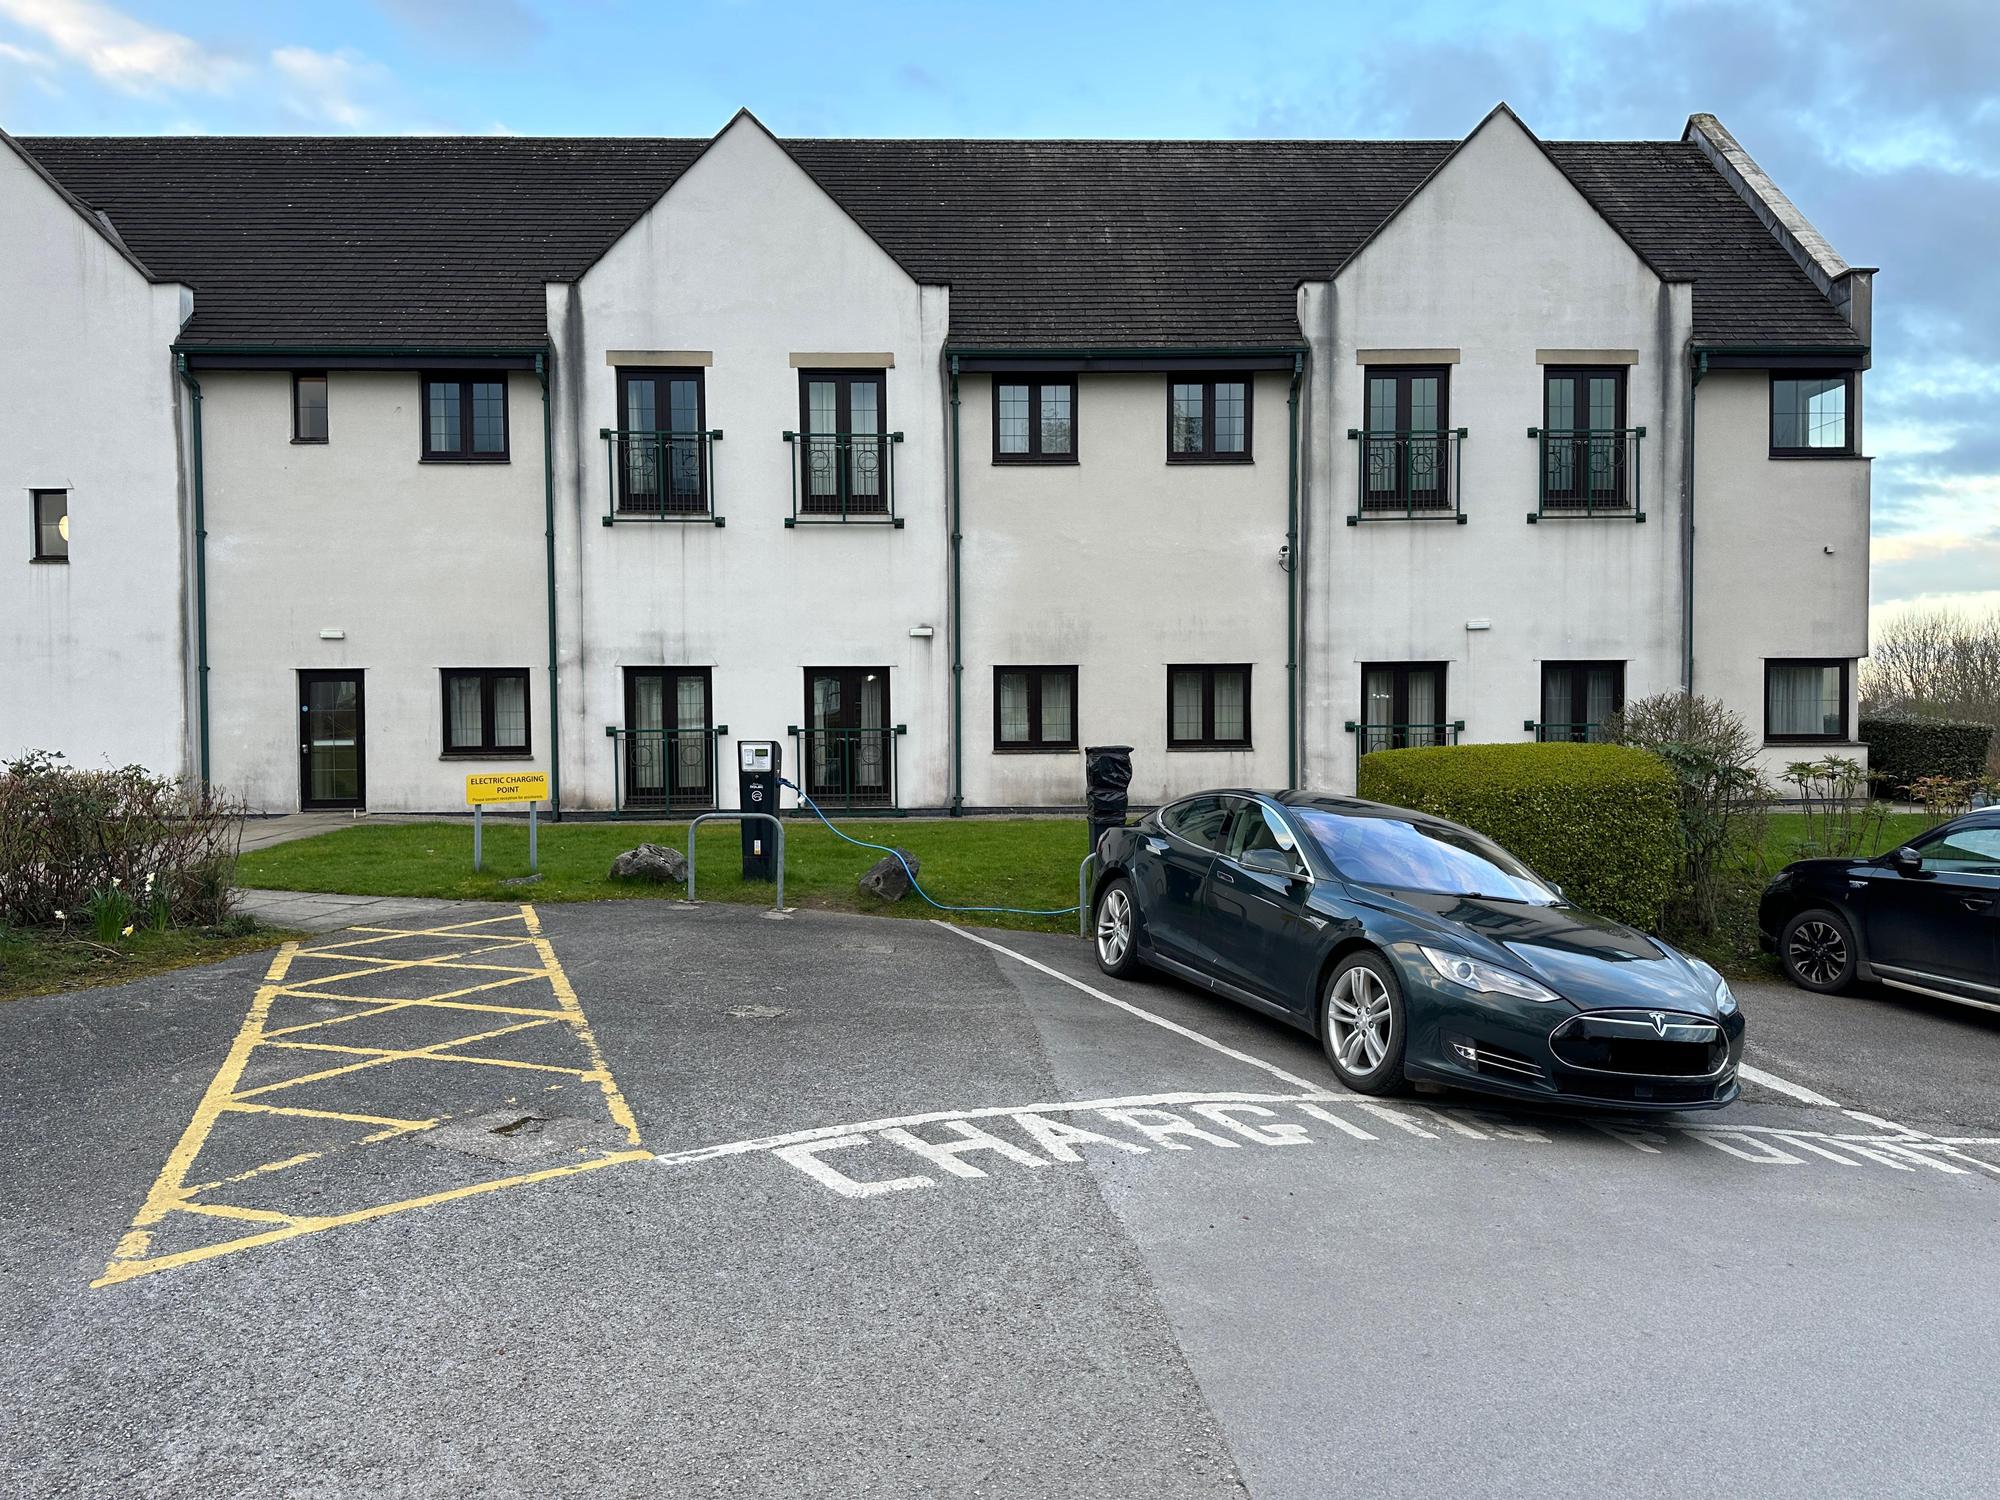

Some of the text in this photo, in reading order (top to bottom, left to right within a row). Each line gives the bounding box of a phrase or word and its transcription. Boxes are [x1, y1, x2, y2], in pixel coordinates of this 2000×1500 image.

[471, 775, 544, 785] ELECTRIC CHARGING
[773, 1103, 1552, 1197] CHARGING
